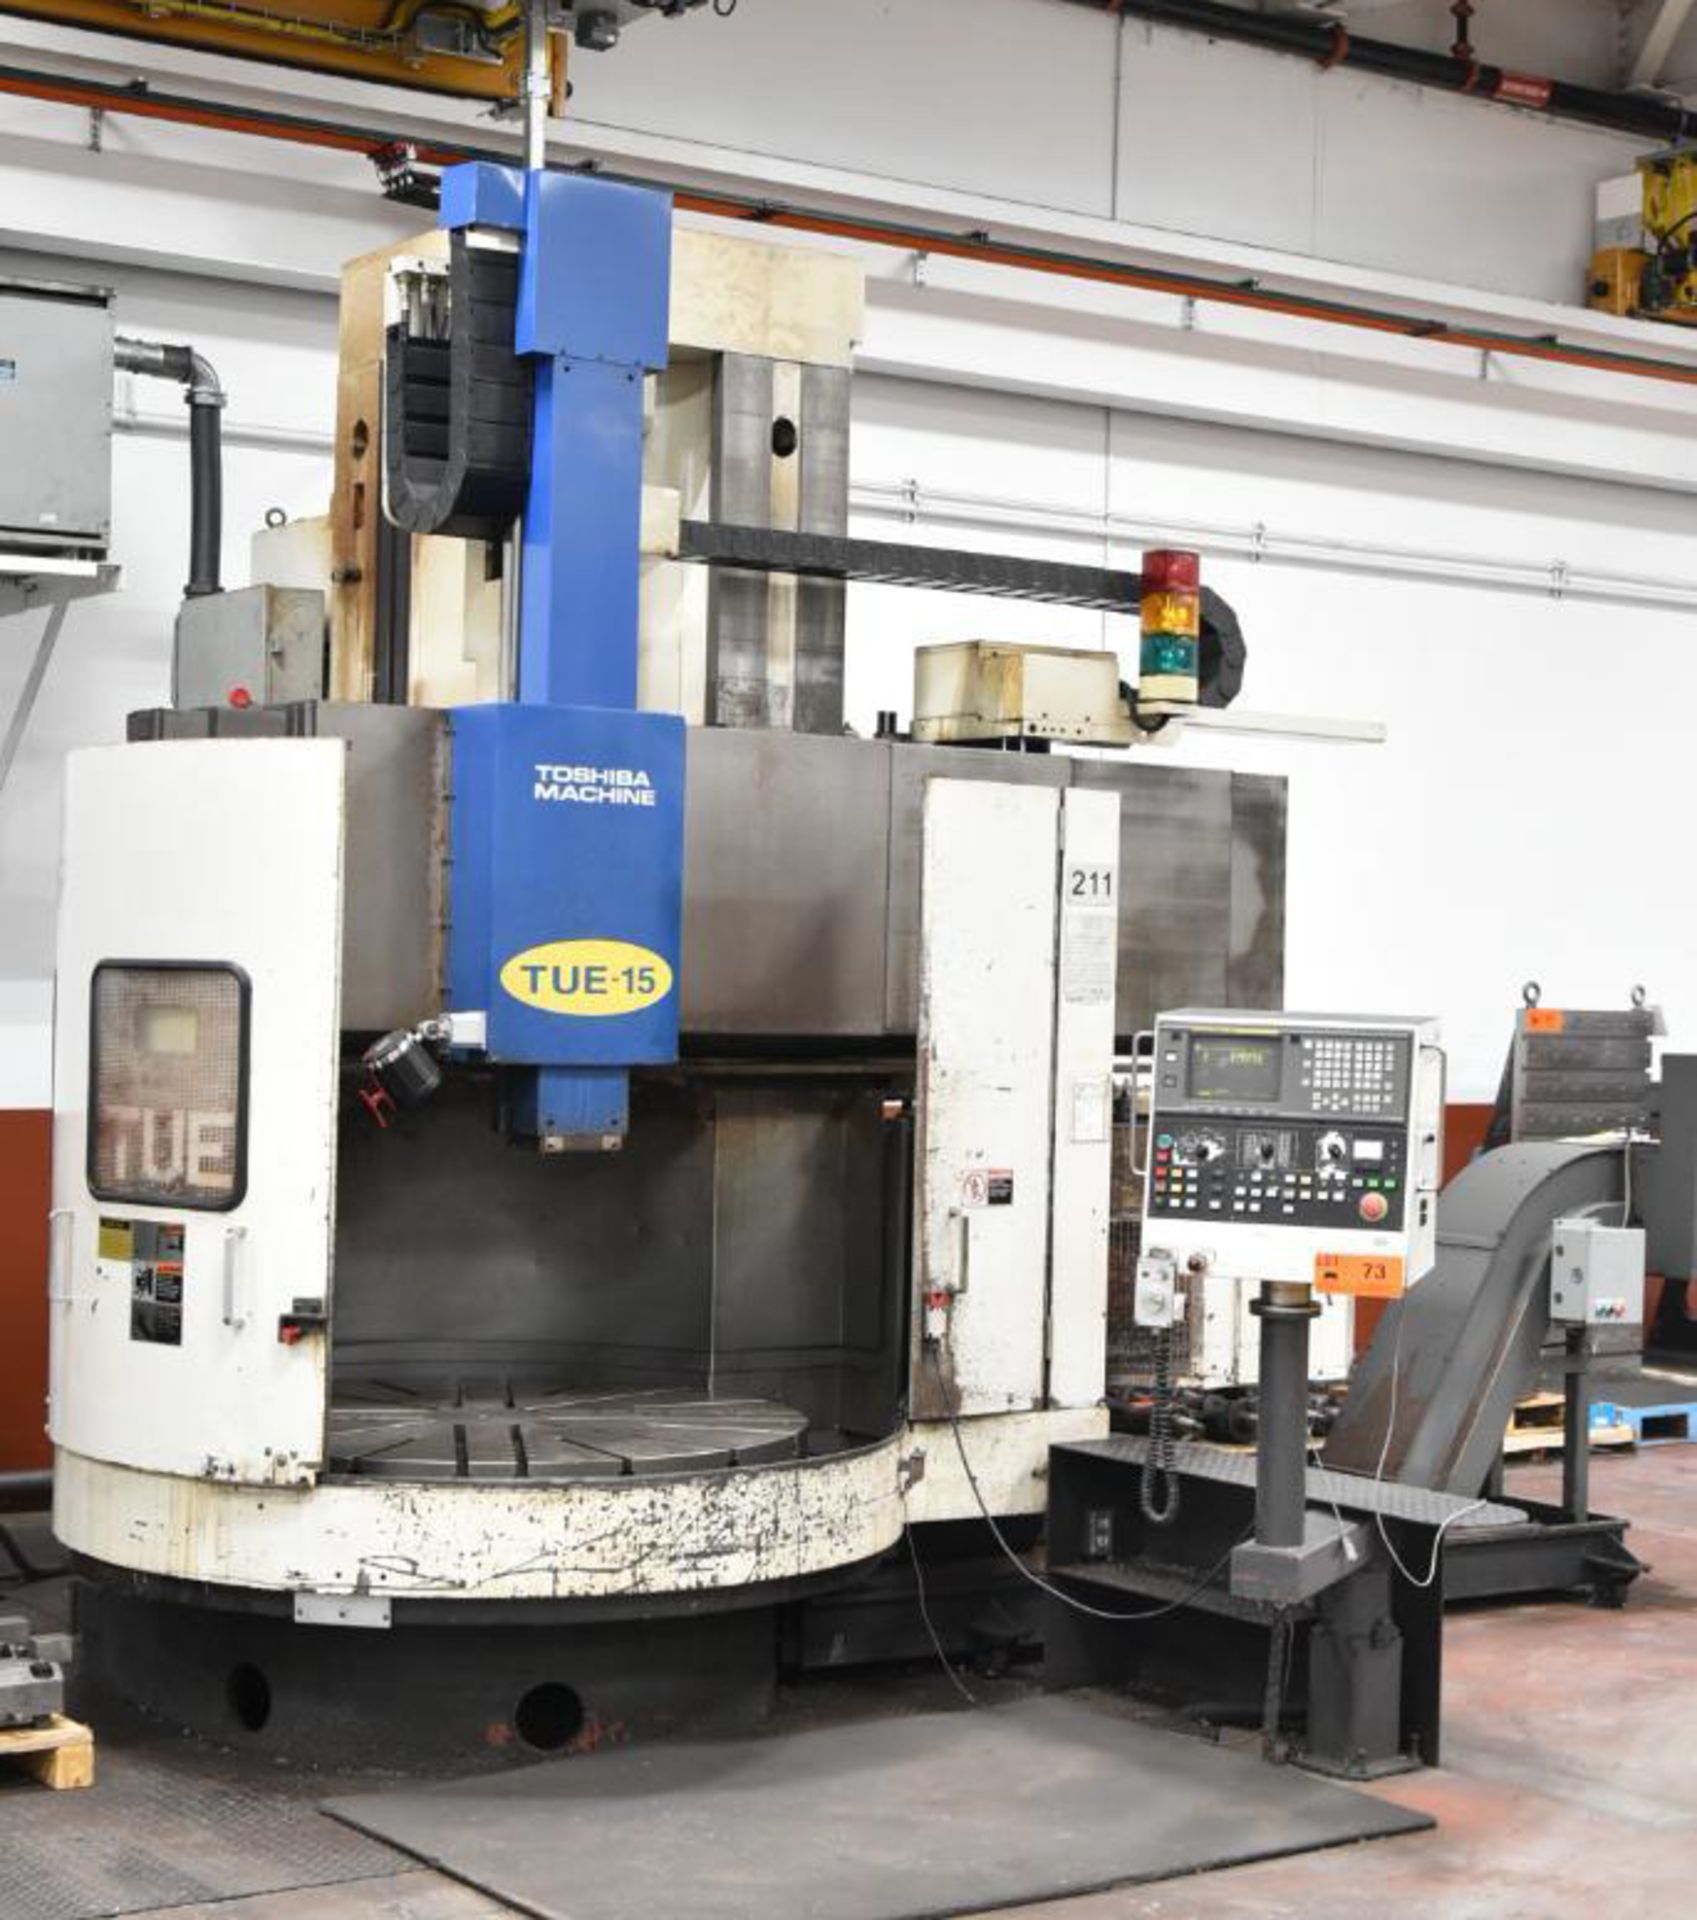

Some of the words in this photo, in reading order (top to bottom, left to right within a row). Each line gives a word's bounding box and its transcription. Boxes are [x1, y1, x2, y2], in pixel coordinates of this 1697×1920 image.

[535, 764, 650, 786] TOSHIBA
[534, 783, 656, 806] MACHINE
[1072, 869, 1111, 896] 211
[519, 964, 656, 995] TUE-15
[102, 1107, 235, 1188] TUE
[1362, 1262, 1386, 1280] 73
